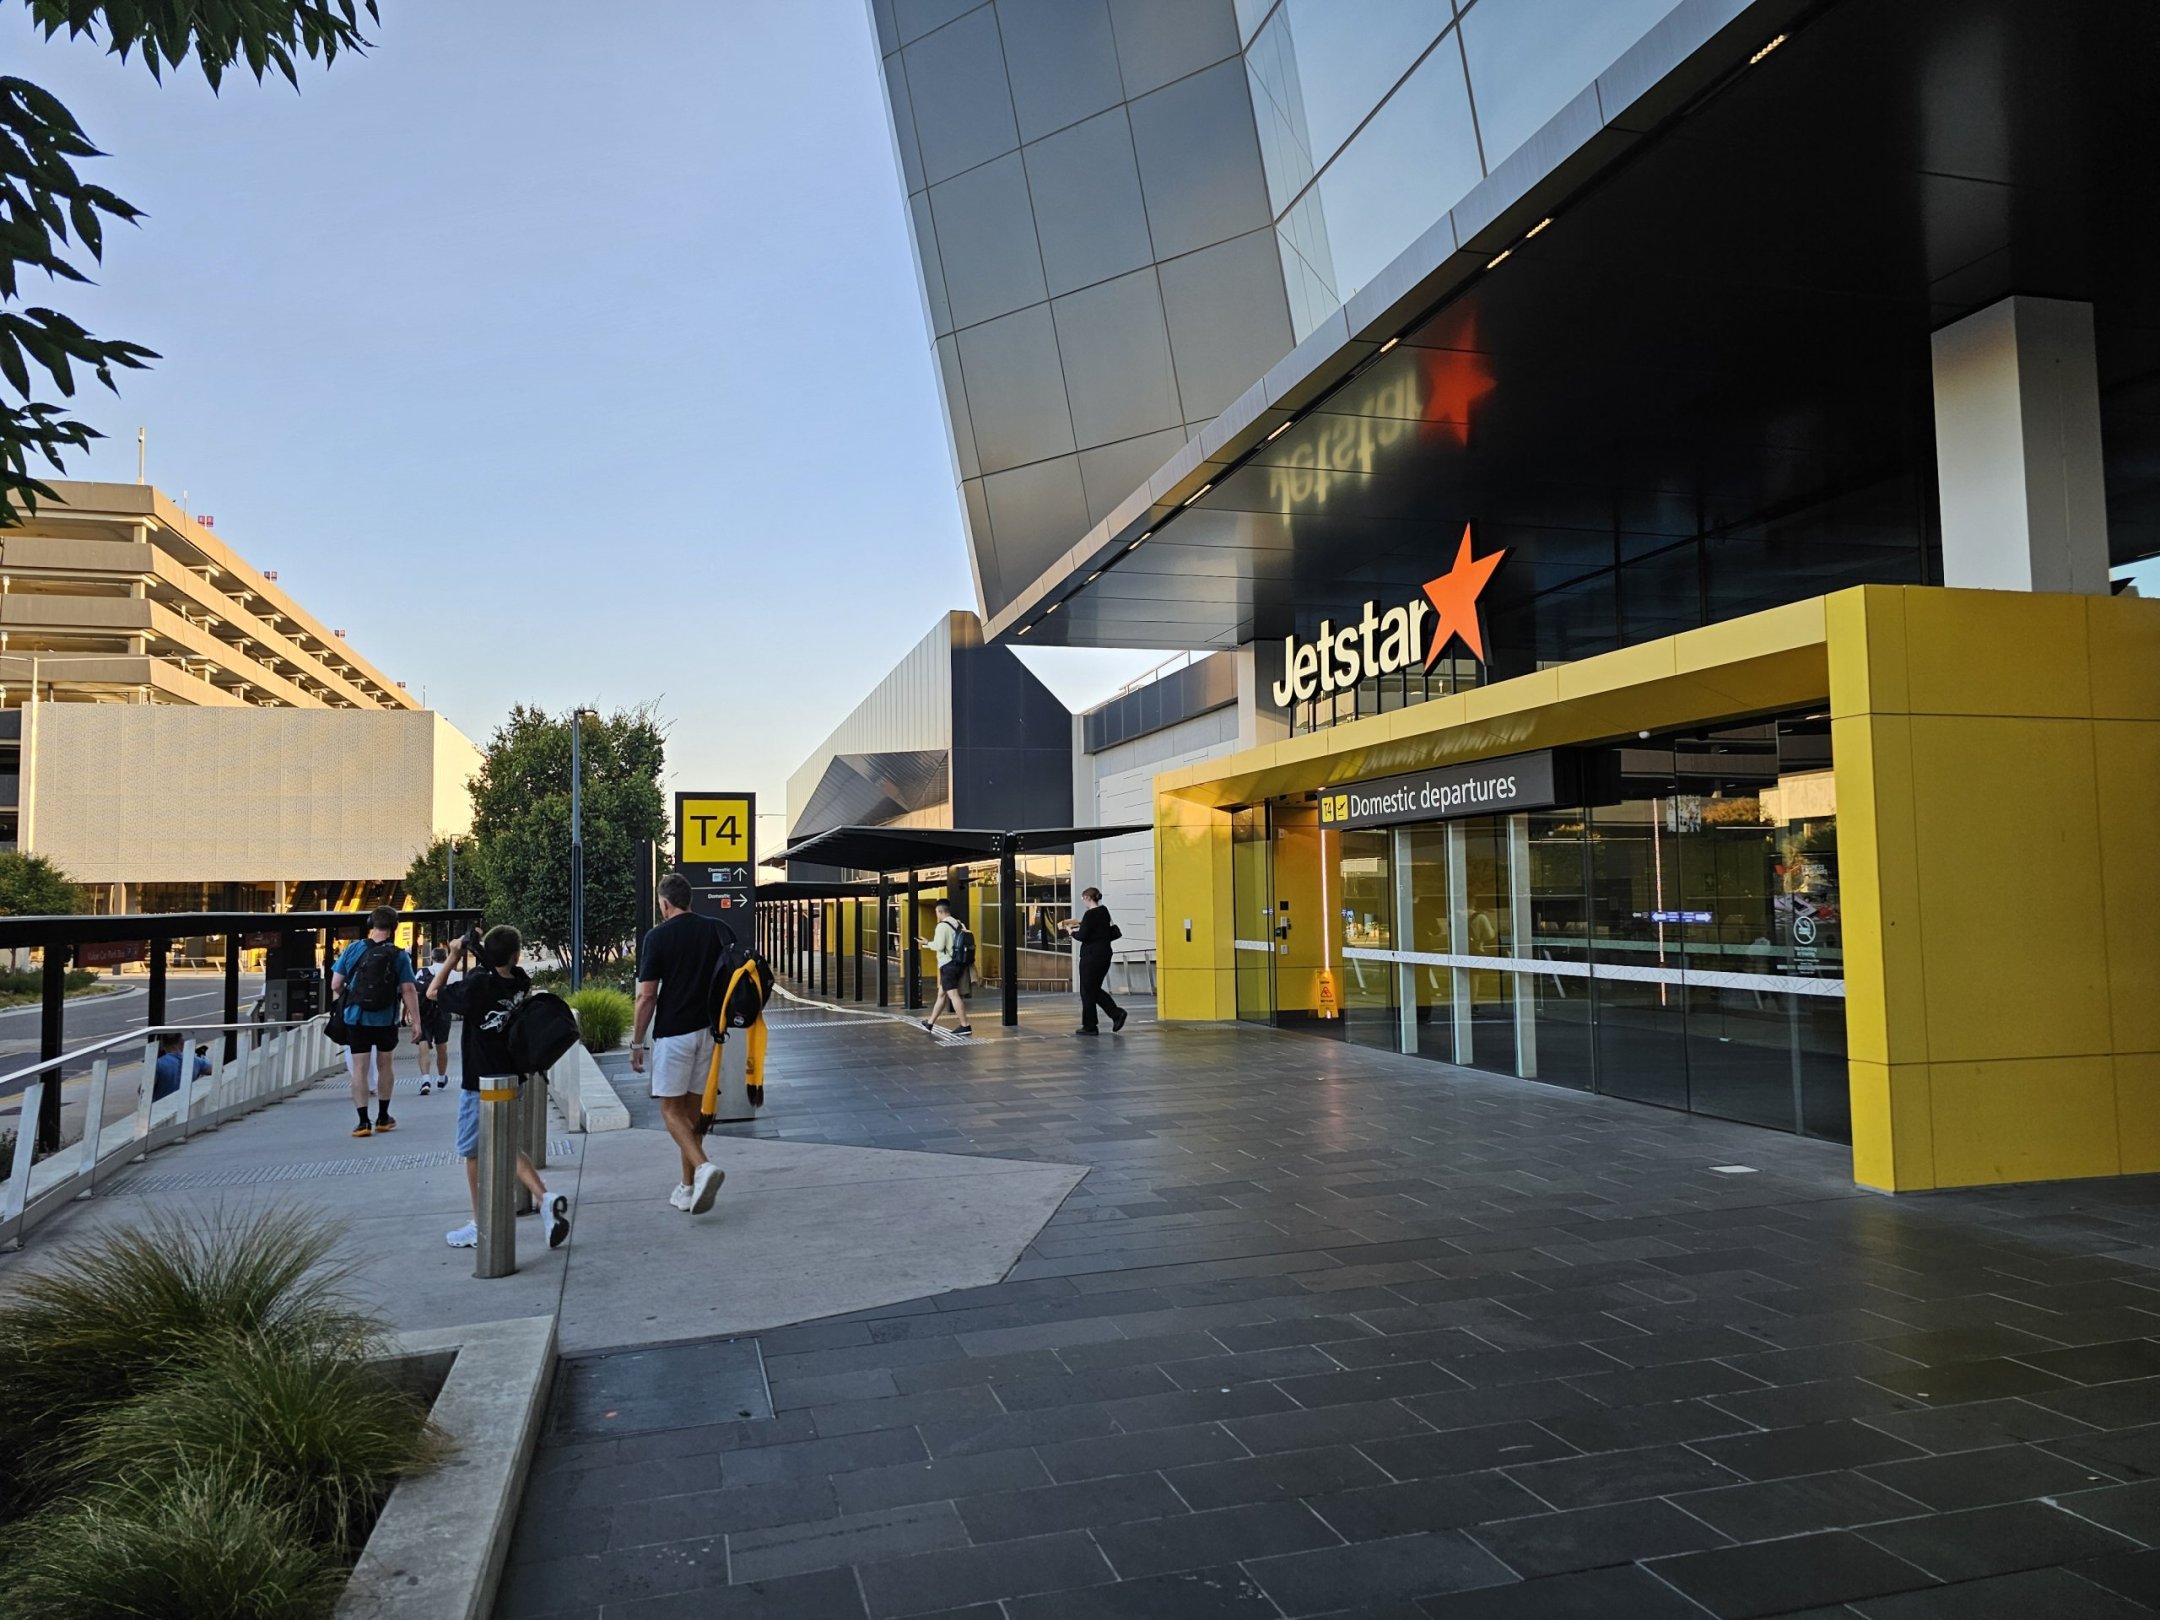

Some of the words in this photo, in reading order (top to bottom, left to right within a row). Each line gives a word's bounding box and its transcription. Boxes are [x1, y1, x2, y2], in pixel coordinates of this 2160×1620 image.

[1272, 599, 1429, 708] Jetstar
[1324, 802, 1332, 816] T4
[1351, 786, 1417, 818] Domestic
[1420, 776, 1517, 813] departures
[690, 816, 742, 846] T4
